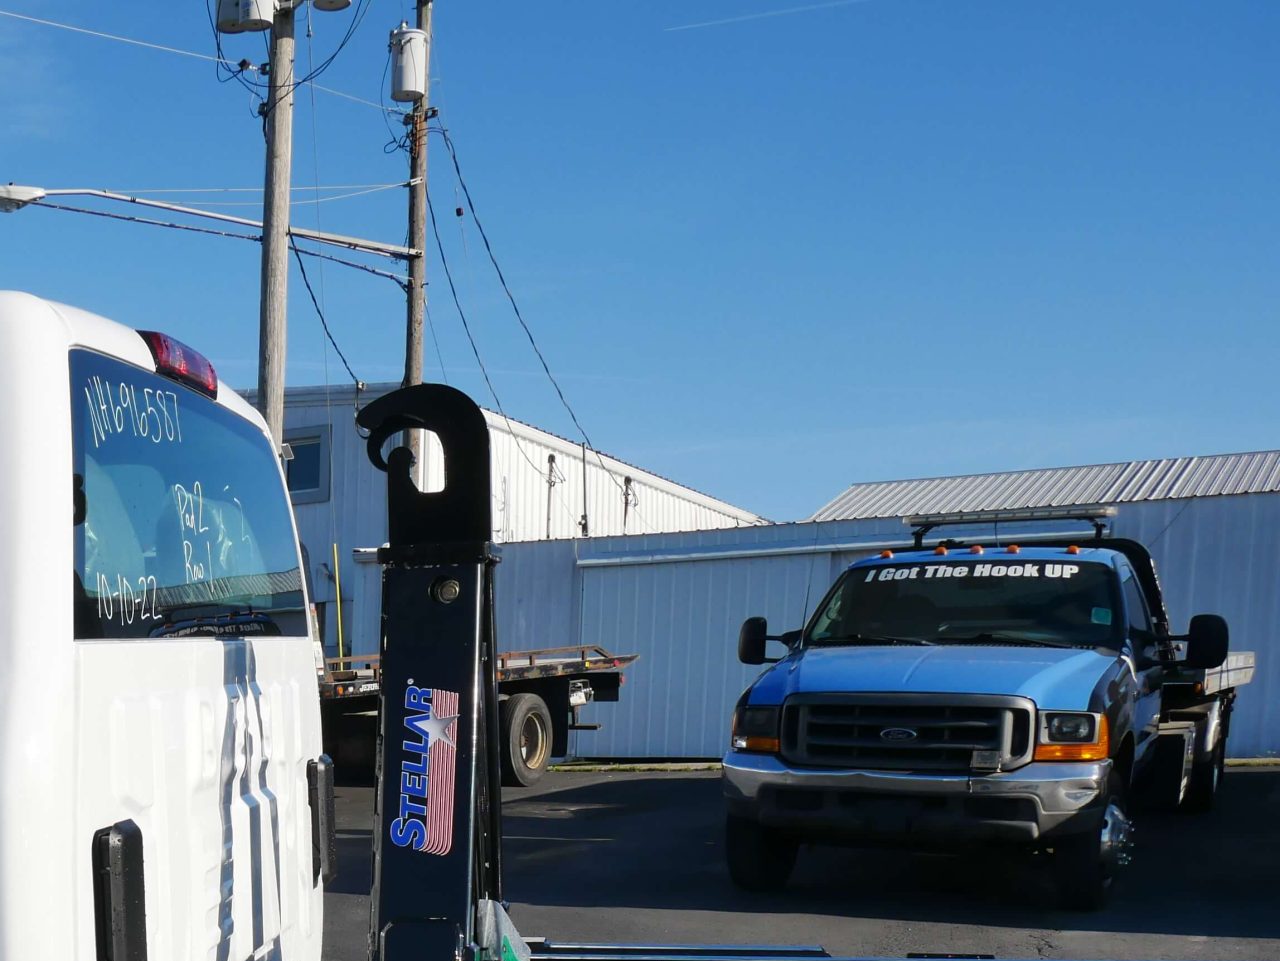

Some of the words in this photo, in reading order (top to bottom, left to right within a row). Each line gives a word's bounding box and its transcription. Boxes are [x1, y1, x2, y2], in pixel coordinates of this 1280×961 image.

[85, 376, 182, 448] NH696587
[175, 483, 197, 536] Pad
[194, 480, 209, 533] 2
[183, 540, 205, 585] Row
[864, 569, 877, 582] I
[878, 567, 920, 582] Got
[923, 565, 969, 578] The
[972, 564, 1039, 577] Hook
[1044, 564, 1079, 579] UP
[96, 571, 163, 627] 10-10-22
[390, 685, 433, 851] STELLAR
